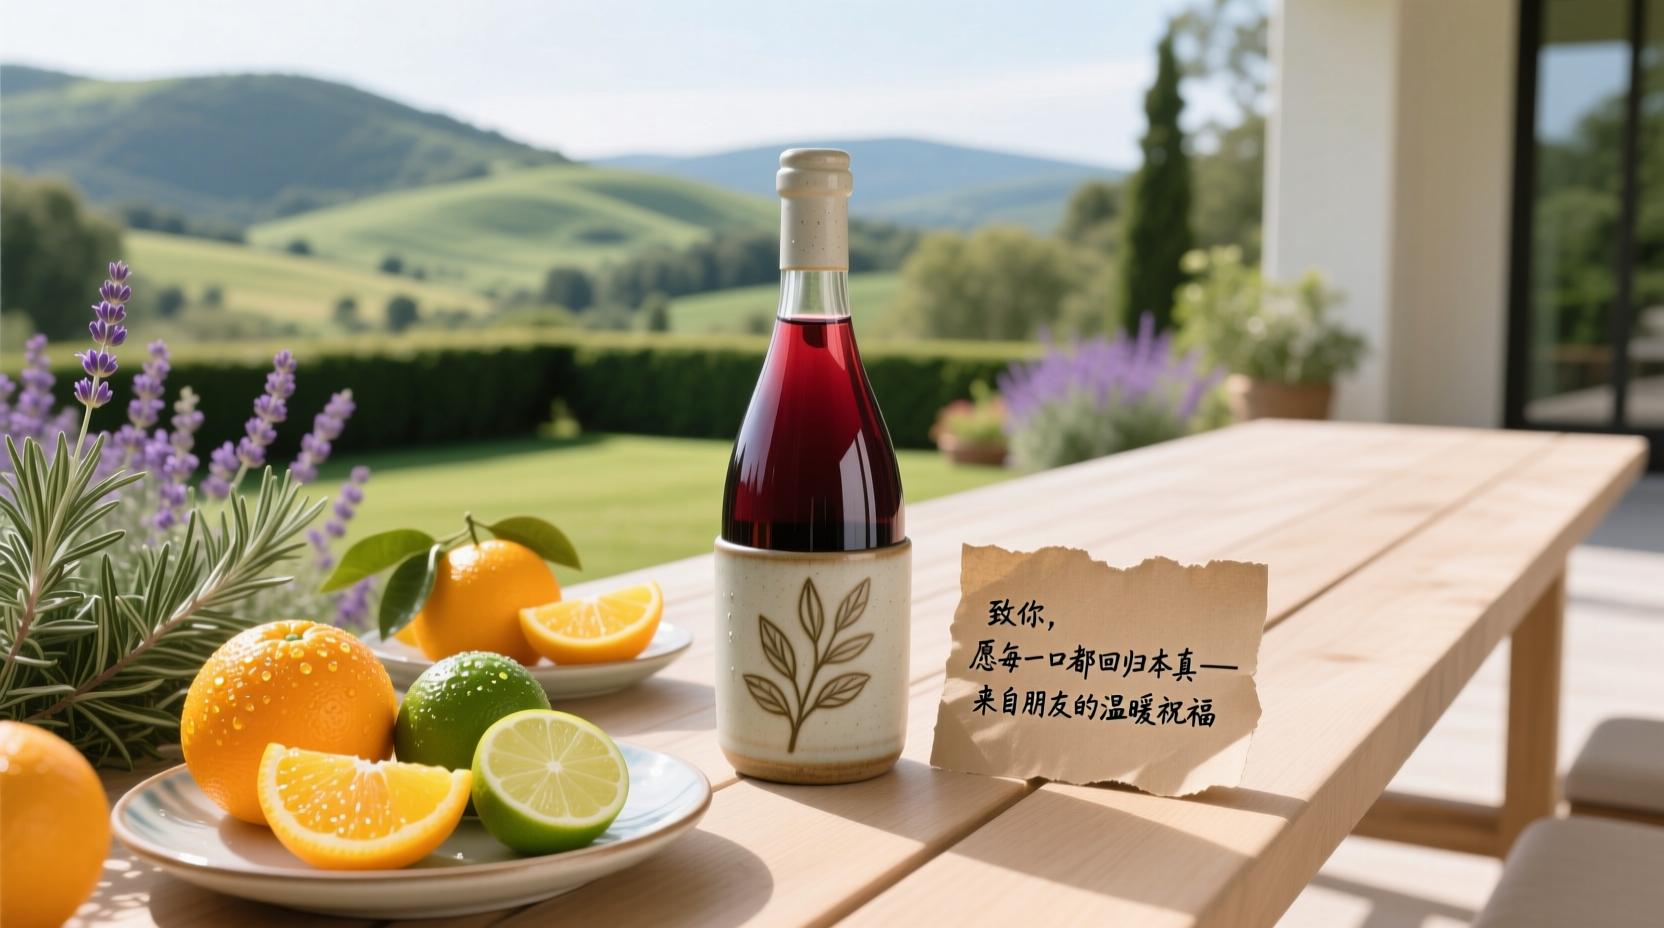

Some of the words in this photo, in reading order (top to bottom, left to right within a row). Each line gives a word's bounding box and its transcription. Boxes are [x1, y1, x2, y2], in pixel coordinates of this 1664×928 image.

[971, 684, 1217, 728] 来自朋友的温暖祝福
